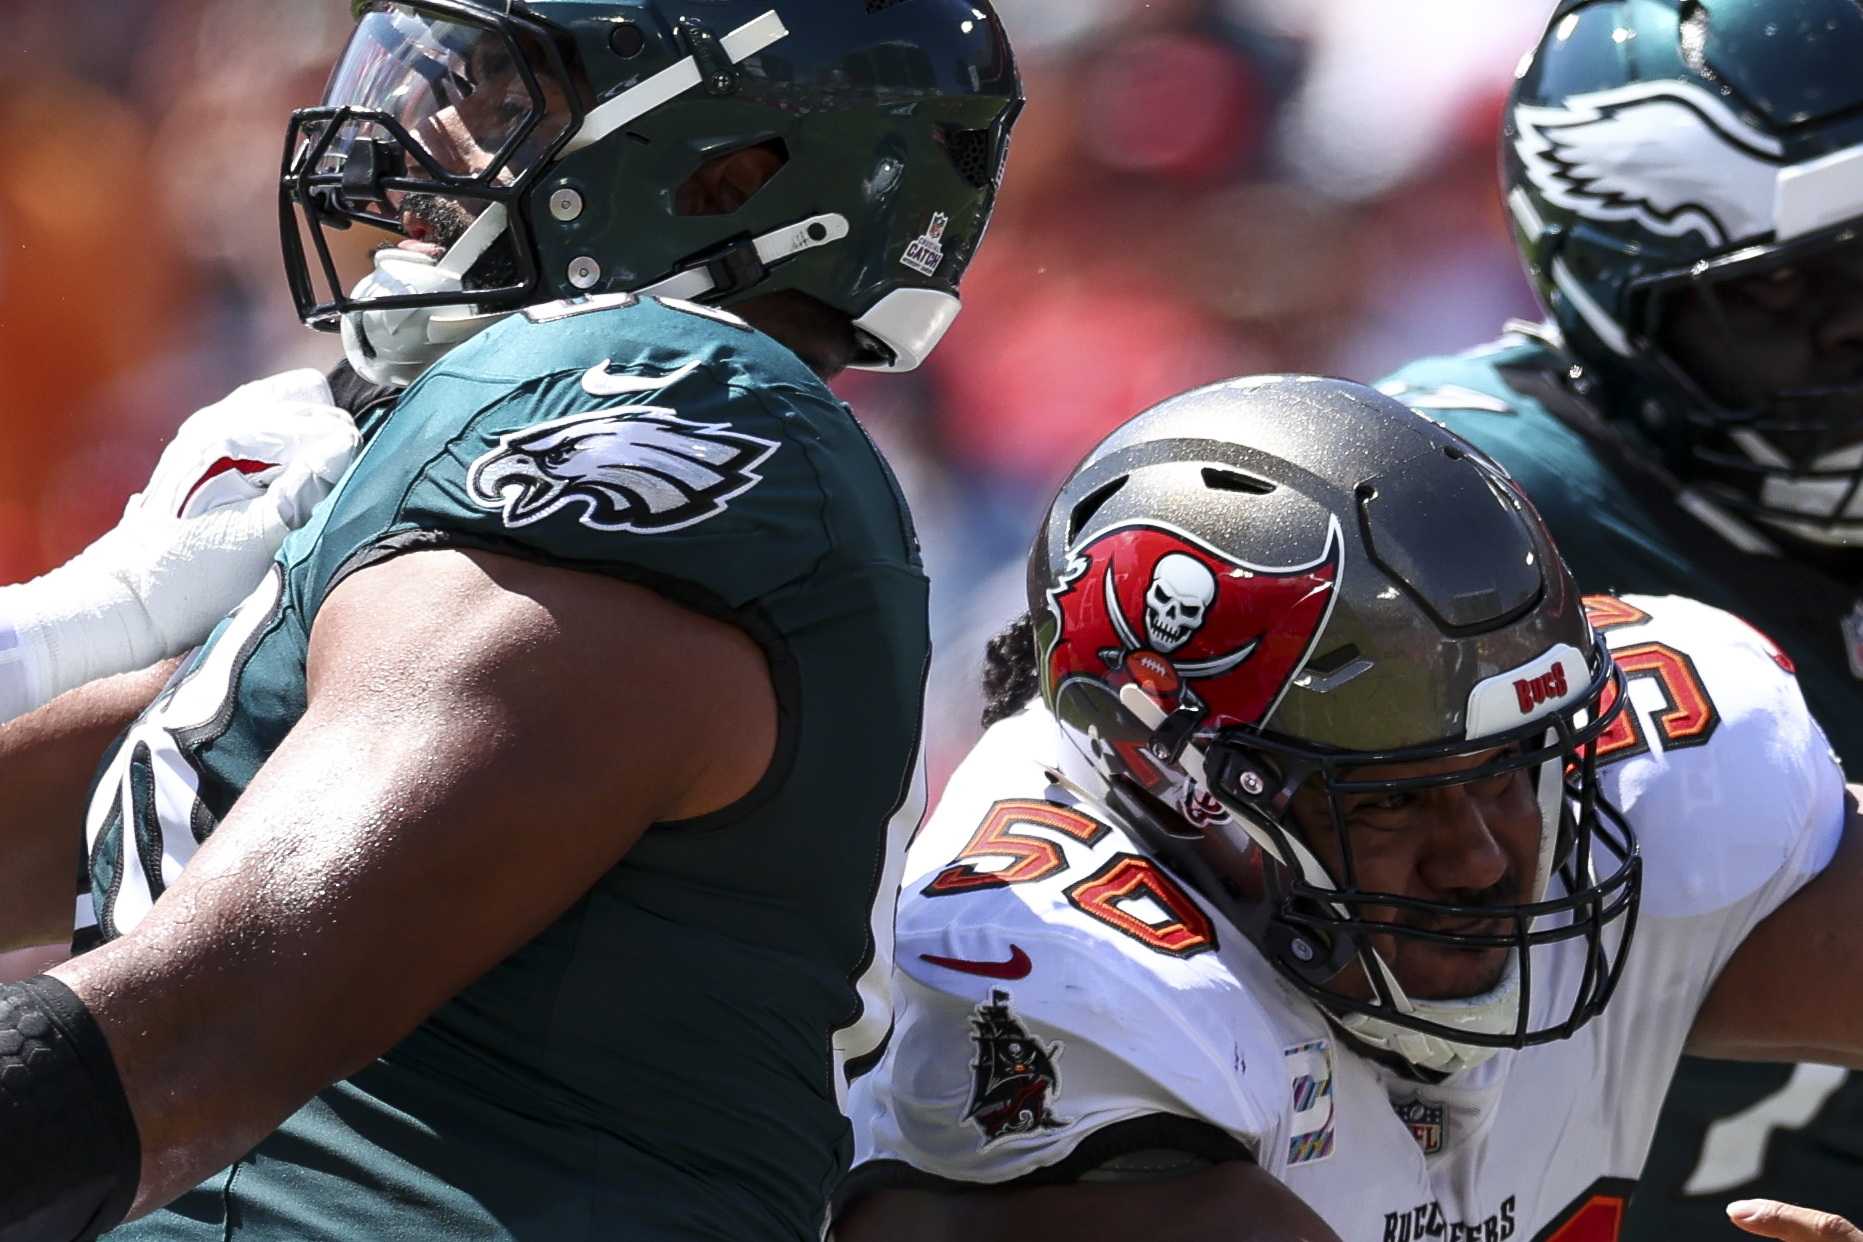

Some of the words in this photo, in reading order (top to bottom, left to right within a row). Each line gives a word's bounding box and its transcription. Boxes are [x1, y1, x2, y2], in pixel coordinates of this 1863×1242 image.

[906, 243, 940, 268] CATCH
[1513, 661, 1567, 715] BUCS
[920, 798, 1221, 960] 50
